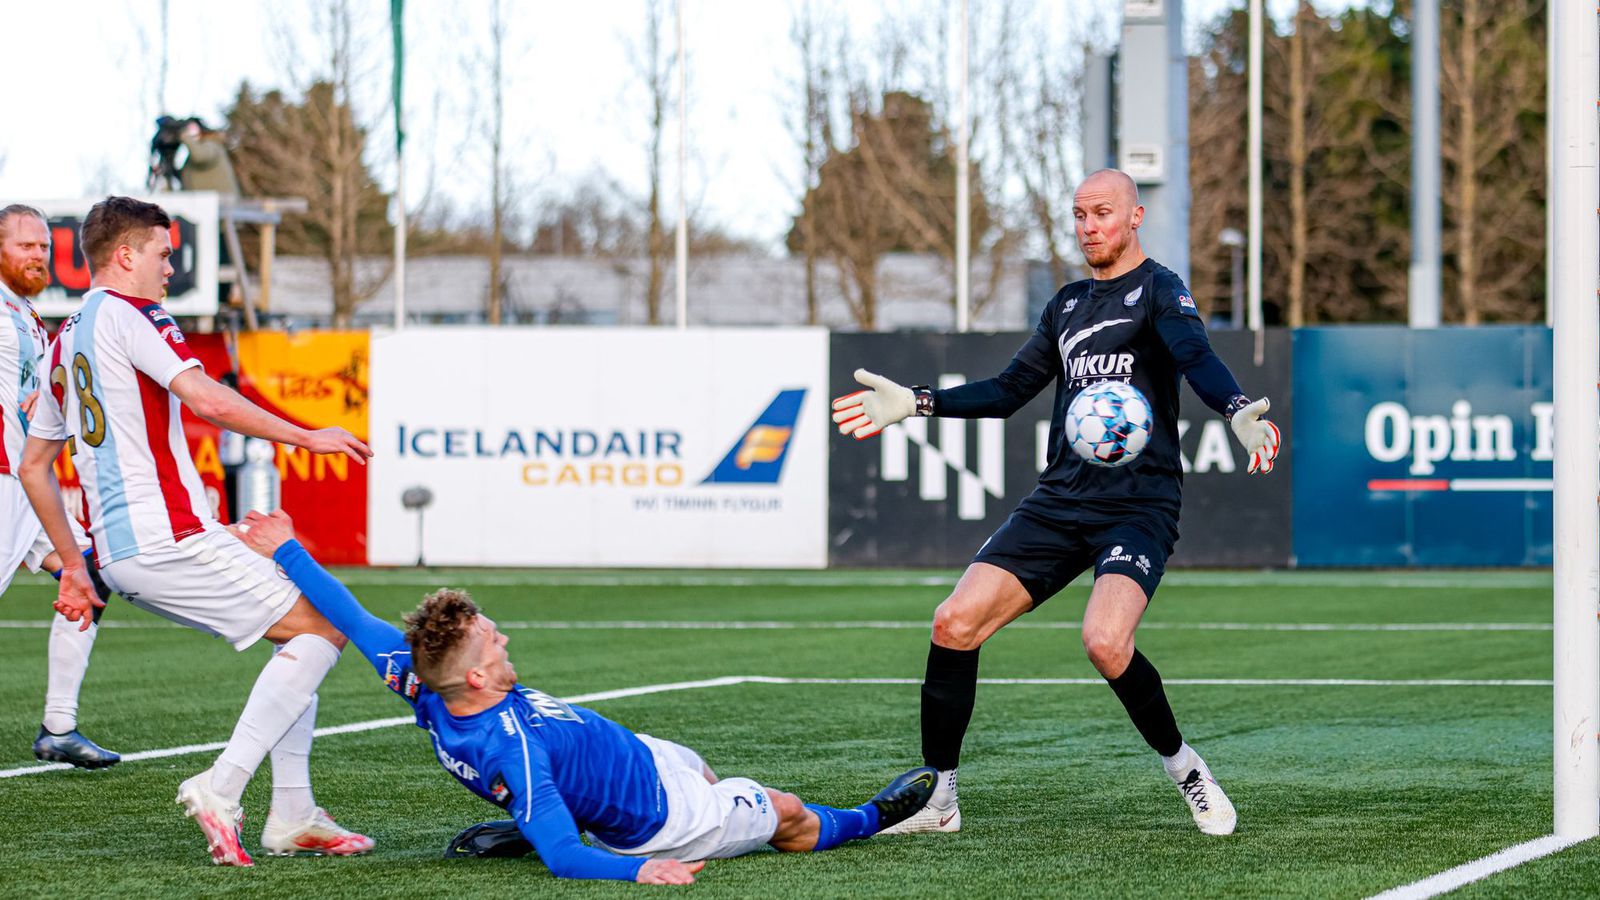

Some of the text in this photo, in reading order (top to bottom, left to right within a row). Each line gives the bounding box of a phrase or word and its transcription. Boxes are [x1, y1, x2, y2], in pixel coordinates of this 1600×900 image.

[1068, 350, 1135, 378] VÍKUR
[50, 351, 106, 456] 28
[398, 424, 683, 458] ICELANDAIR
[1364, 401, 1517, 476] Opin
[521, 463, 684, 486] CARGO
